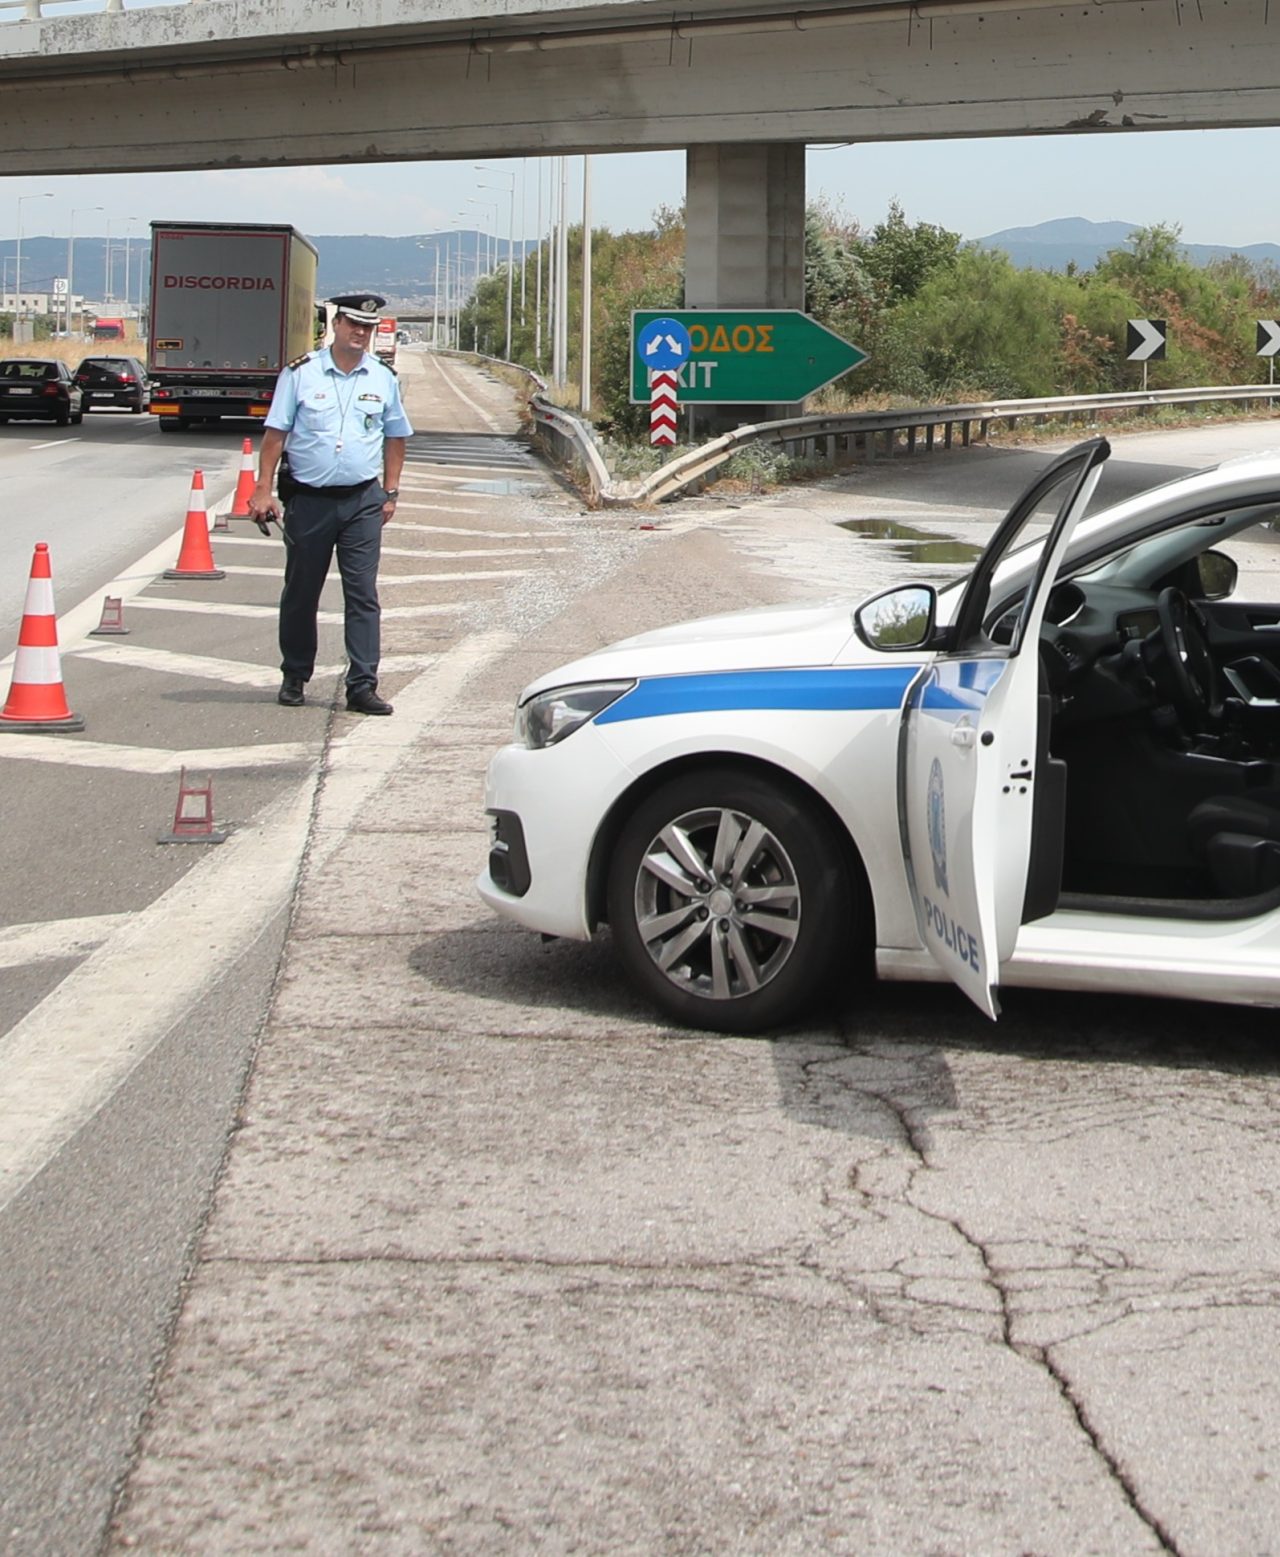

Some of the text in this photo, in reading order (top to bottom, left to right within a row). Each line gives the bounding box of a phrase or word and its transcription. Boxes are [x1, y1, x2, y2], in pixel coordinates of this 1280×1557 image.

[164, 275, 275, 290] DISCORDIA
[688, 325, 774, 352] ΟΔΟΣ
[924, 896, 979, 973] POLICE
